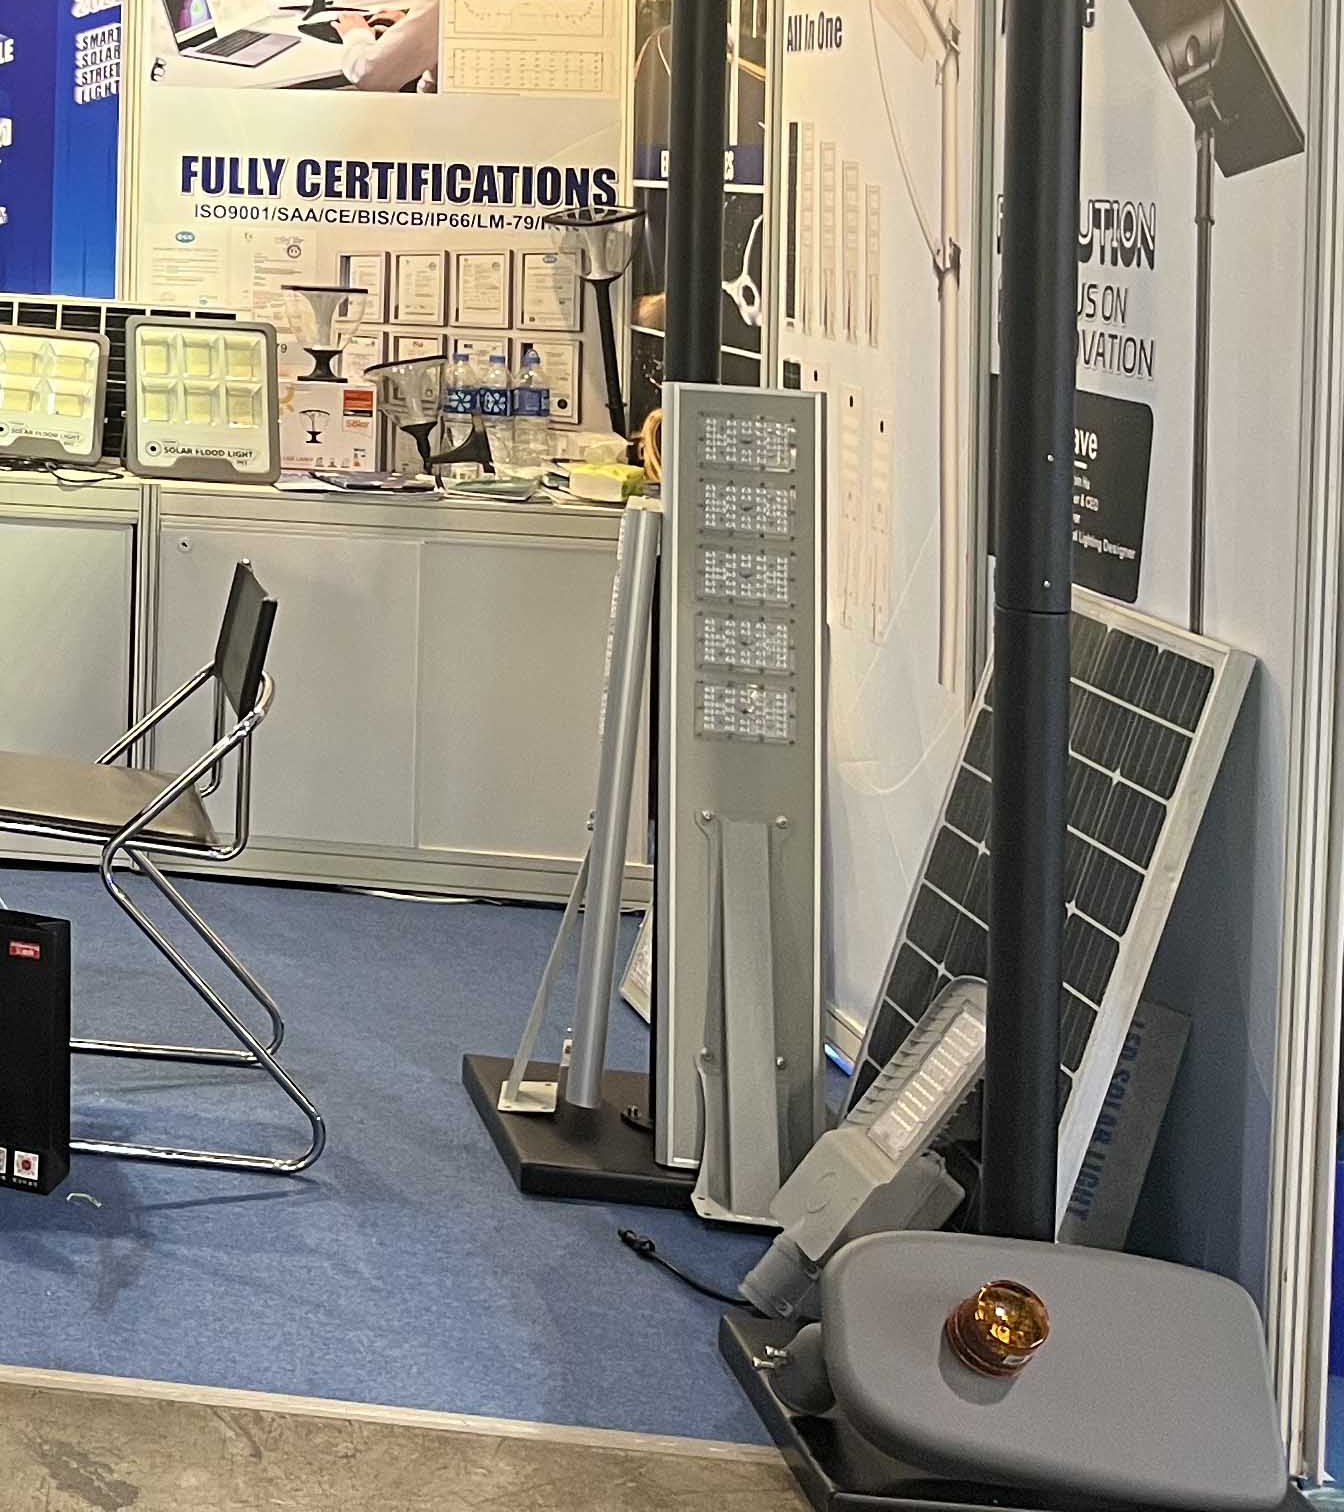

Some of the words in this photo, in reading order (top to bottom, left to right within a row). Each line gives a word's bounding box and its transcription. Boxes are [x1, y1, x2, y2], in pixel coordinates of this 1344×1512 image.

[786, 14, 802, 52] All
[817, 10, 843, 50] One
[181, 155, 286, 197] FULLY
[297, 158, 616, 209] CERTIFICATIONS
[1102, 285, 1128, 324] ON
[164, 446, 192, 455] SOLAR
[228, 450, 254, 459] LIGHT
